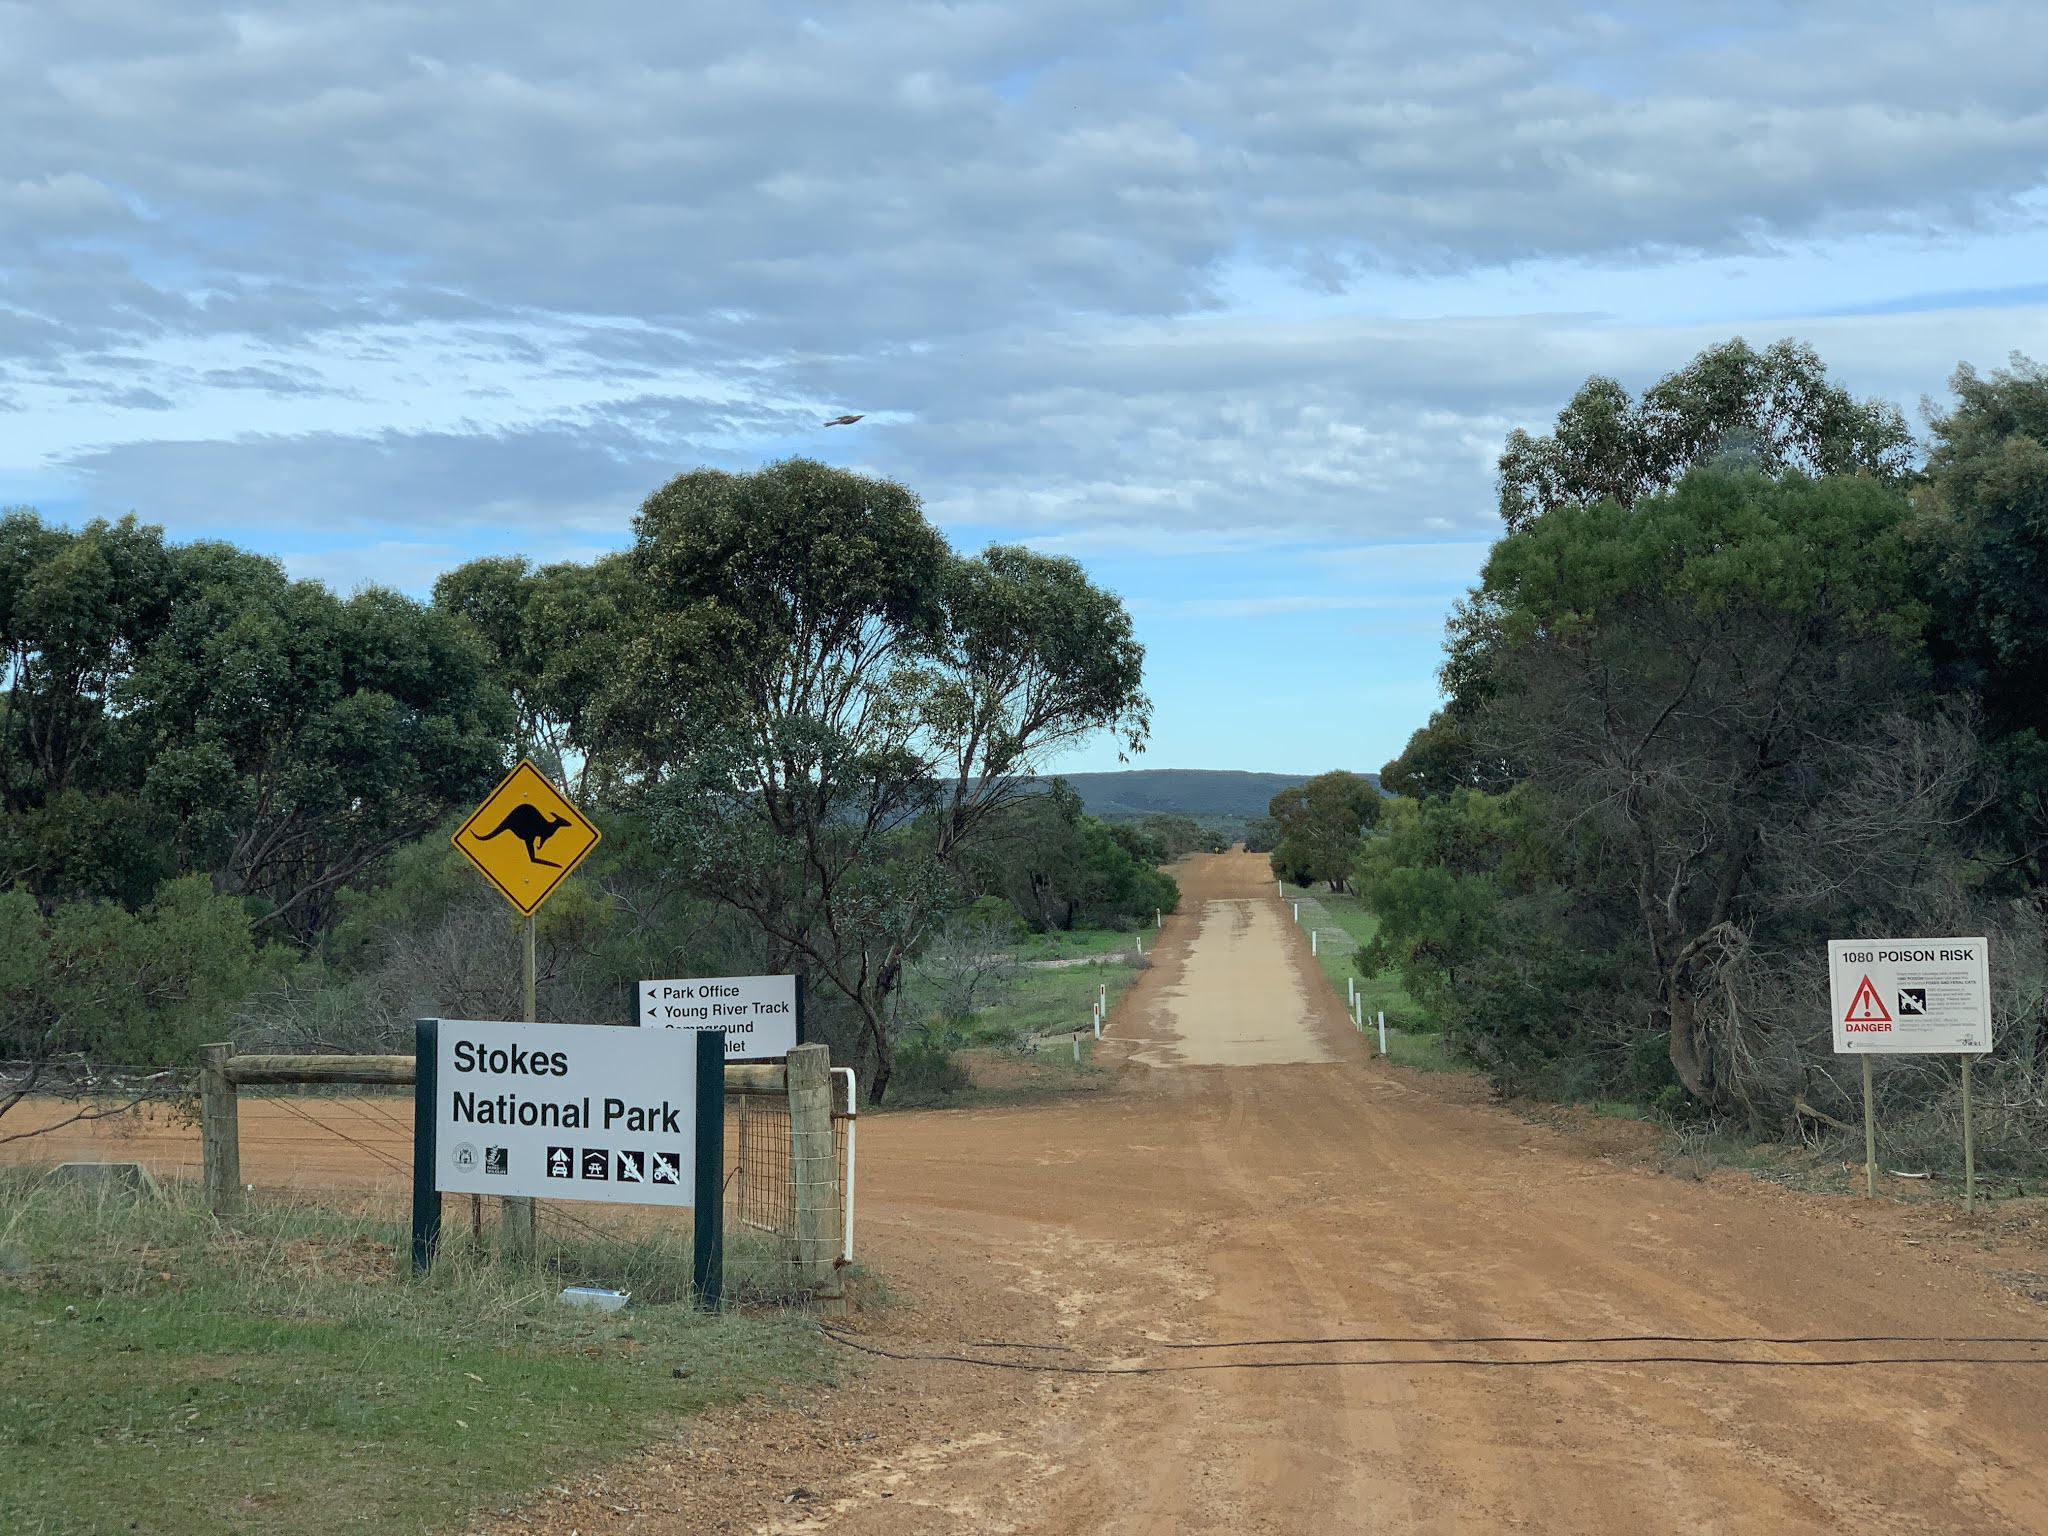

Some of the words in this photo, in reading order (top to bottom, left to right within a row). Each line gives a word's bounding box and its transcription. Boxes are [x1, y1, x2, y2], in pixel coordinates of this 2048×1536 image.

[1842, 952, 1874, 963] 1080
[1878, 950, 1935, 962] POISON
[1940, 949, 1974, 961] RISK
[663, 986, 695, 999] Park
[698, 985, 740, 998] Office
[664, 1005, 708, 1019] Young
[712, 1003, 748, 1016] River
[752, 1001, 790, 1014] Track
[1846, 1023, 1892, 1032] DANGER
[453, 1040, 569, 1077] Stokes
[452, 1091, 590, 1129] National
[603, 1097, 681, 1133] Park
